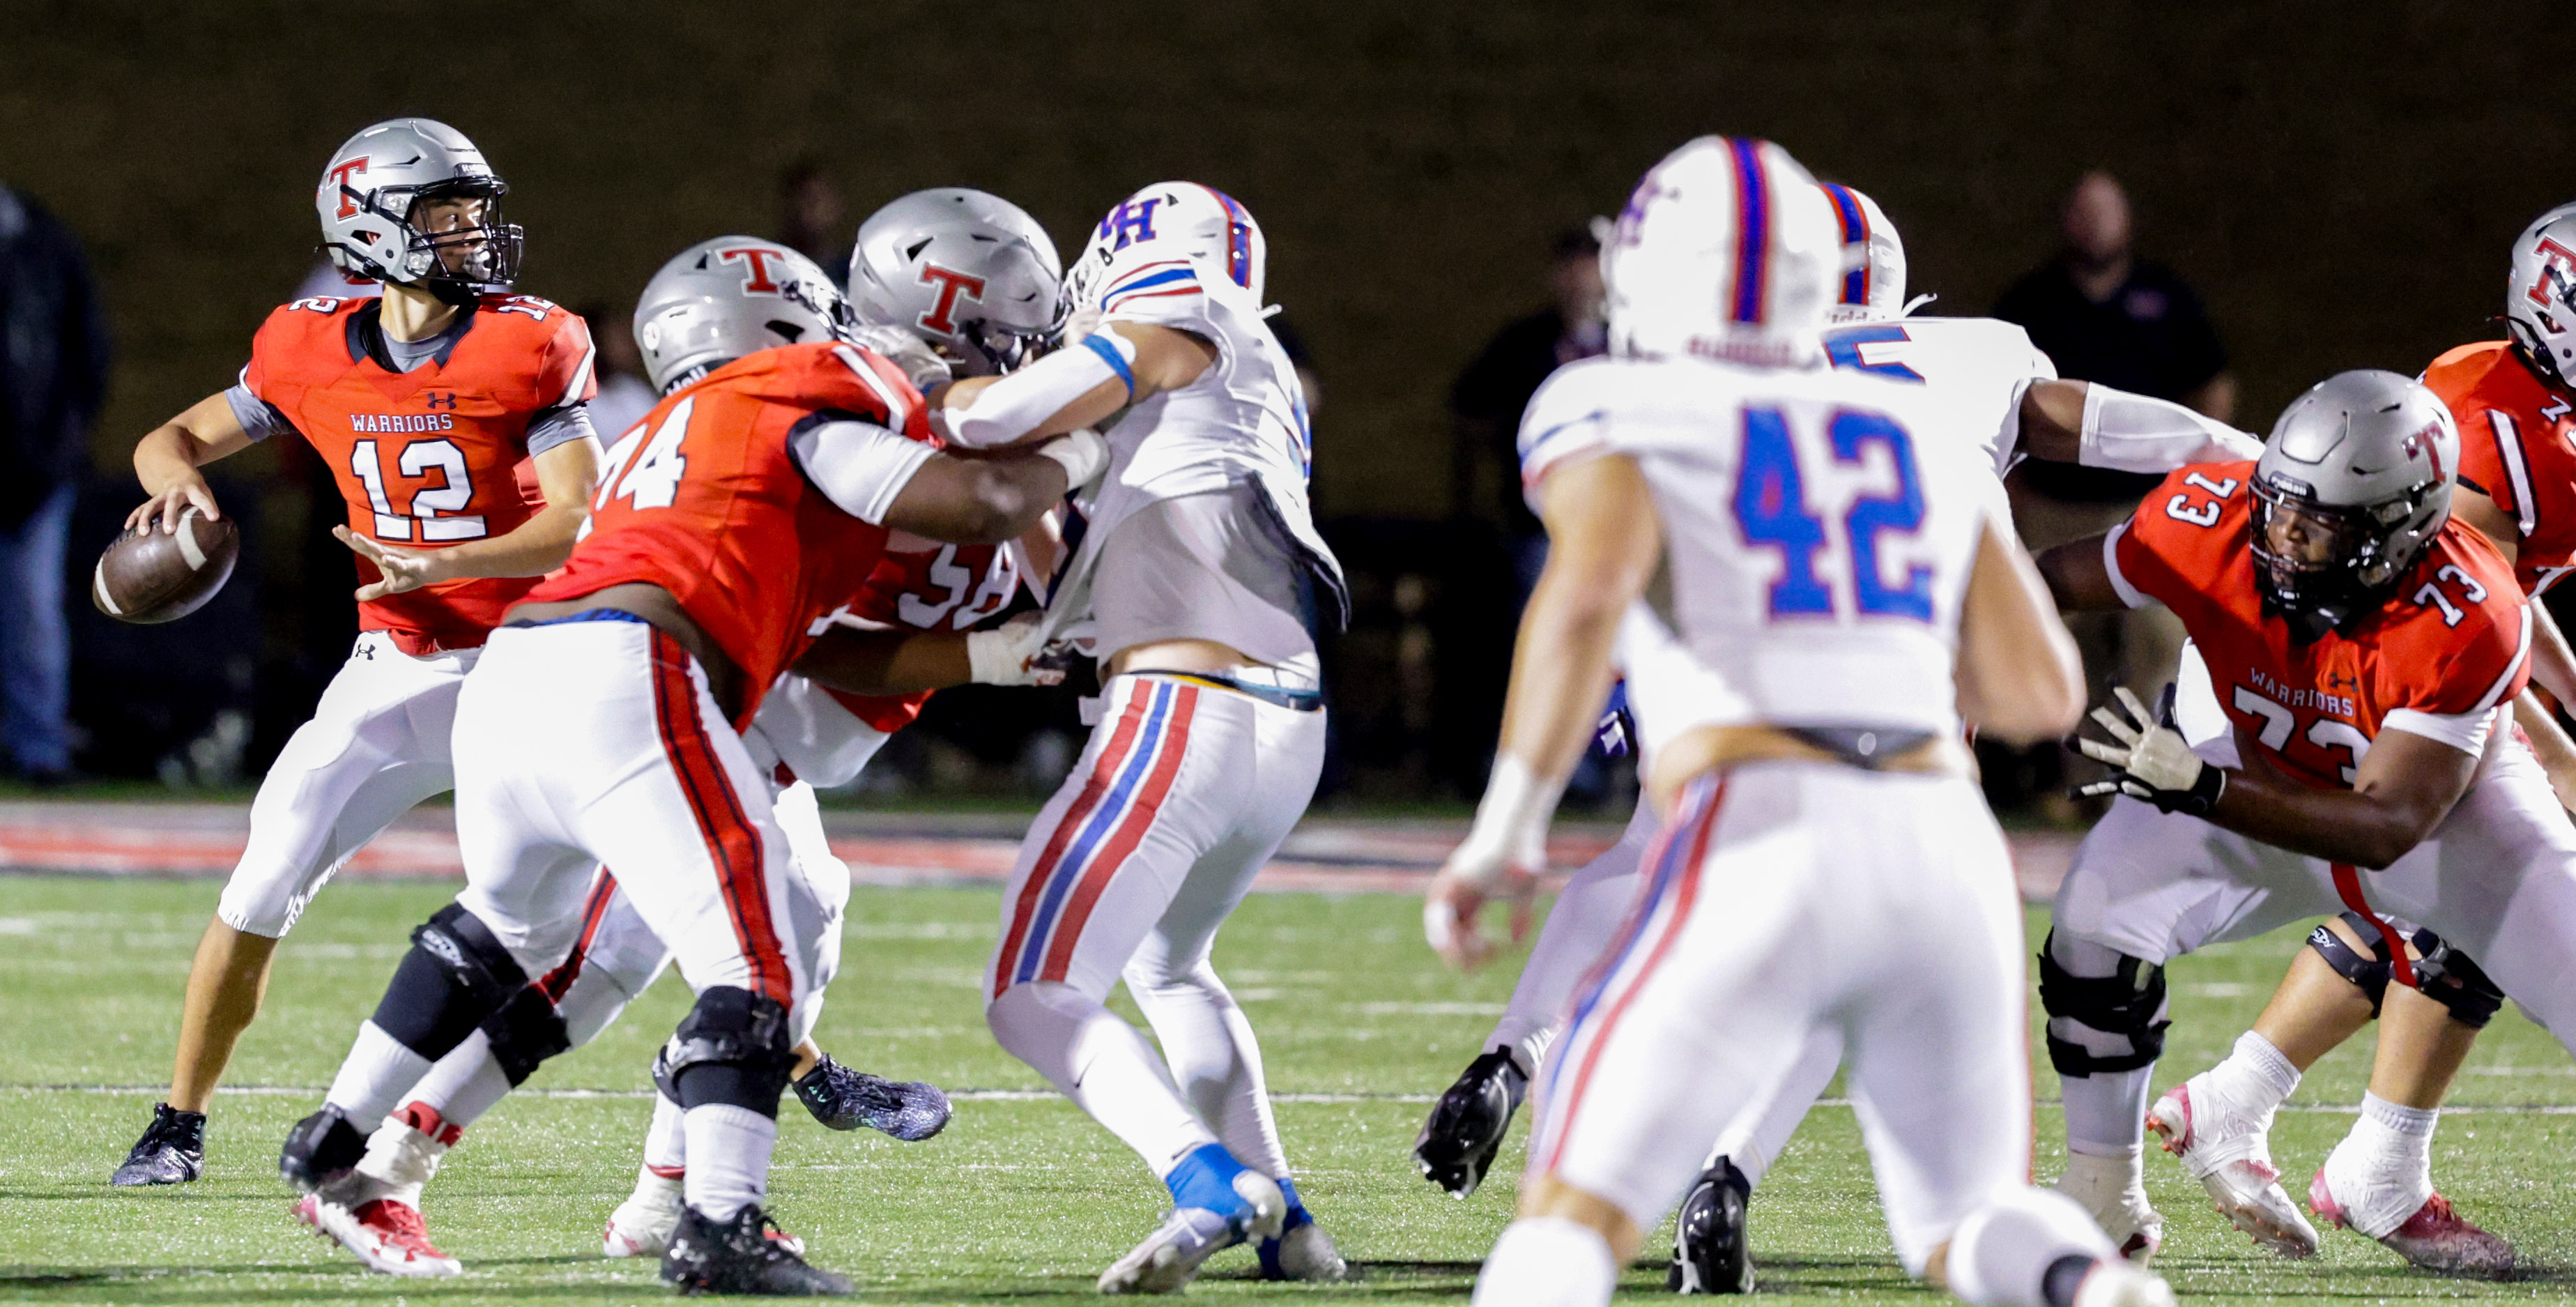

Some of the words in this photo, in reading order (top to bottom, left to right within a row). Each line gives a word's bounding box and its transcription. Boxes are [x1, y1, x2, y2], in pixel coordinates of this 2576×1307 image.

[326, 154, 372, 224] T
[288, 296, 348, 314] 2
[716, 248, 786, 298] T
[916, 261, 985, 337] T
[2525, 234, 2576, 312] T
[497, 295, 556, 322] 12
[350, 413, 454, 434] WARRIORS
[595, 395, 696, 511] 74
[2400, 420, 2446, 484] T
[350, 437, 488, 542] 12
[1731, 403, 1937, 624] 42
[2165, 471, 2239, 528] 73
[2413, 563, 2488, 629] 73
[2251, 666, 2354, 717] WARRIORS
[2232, 683, 2372, 790] 73
